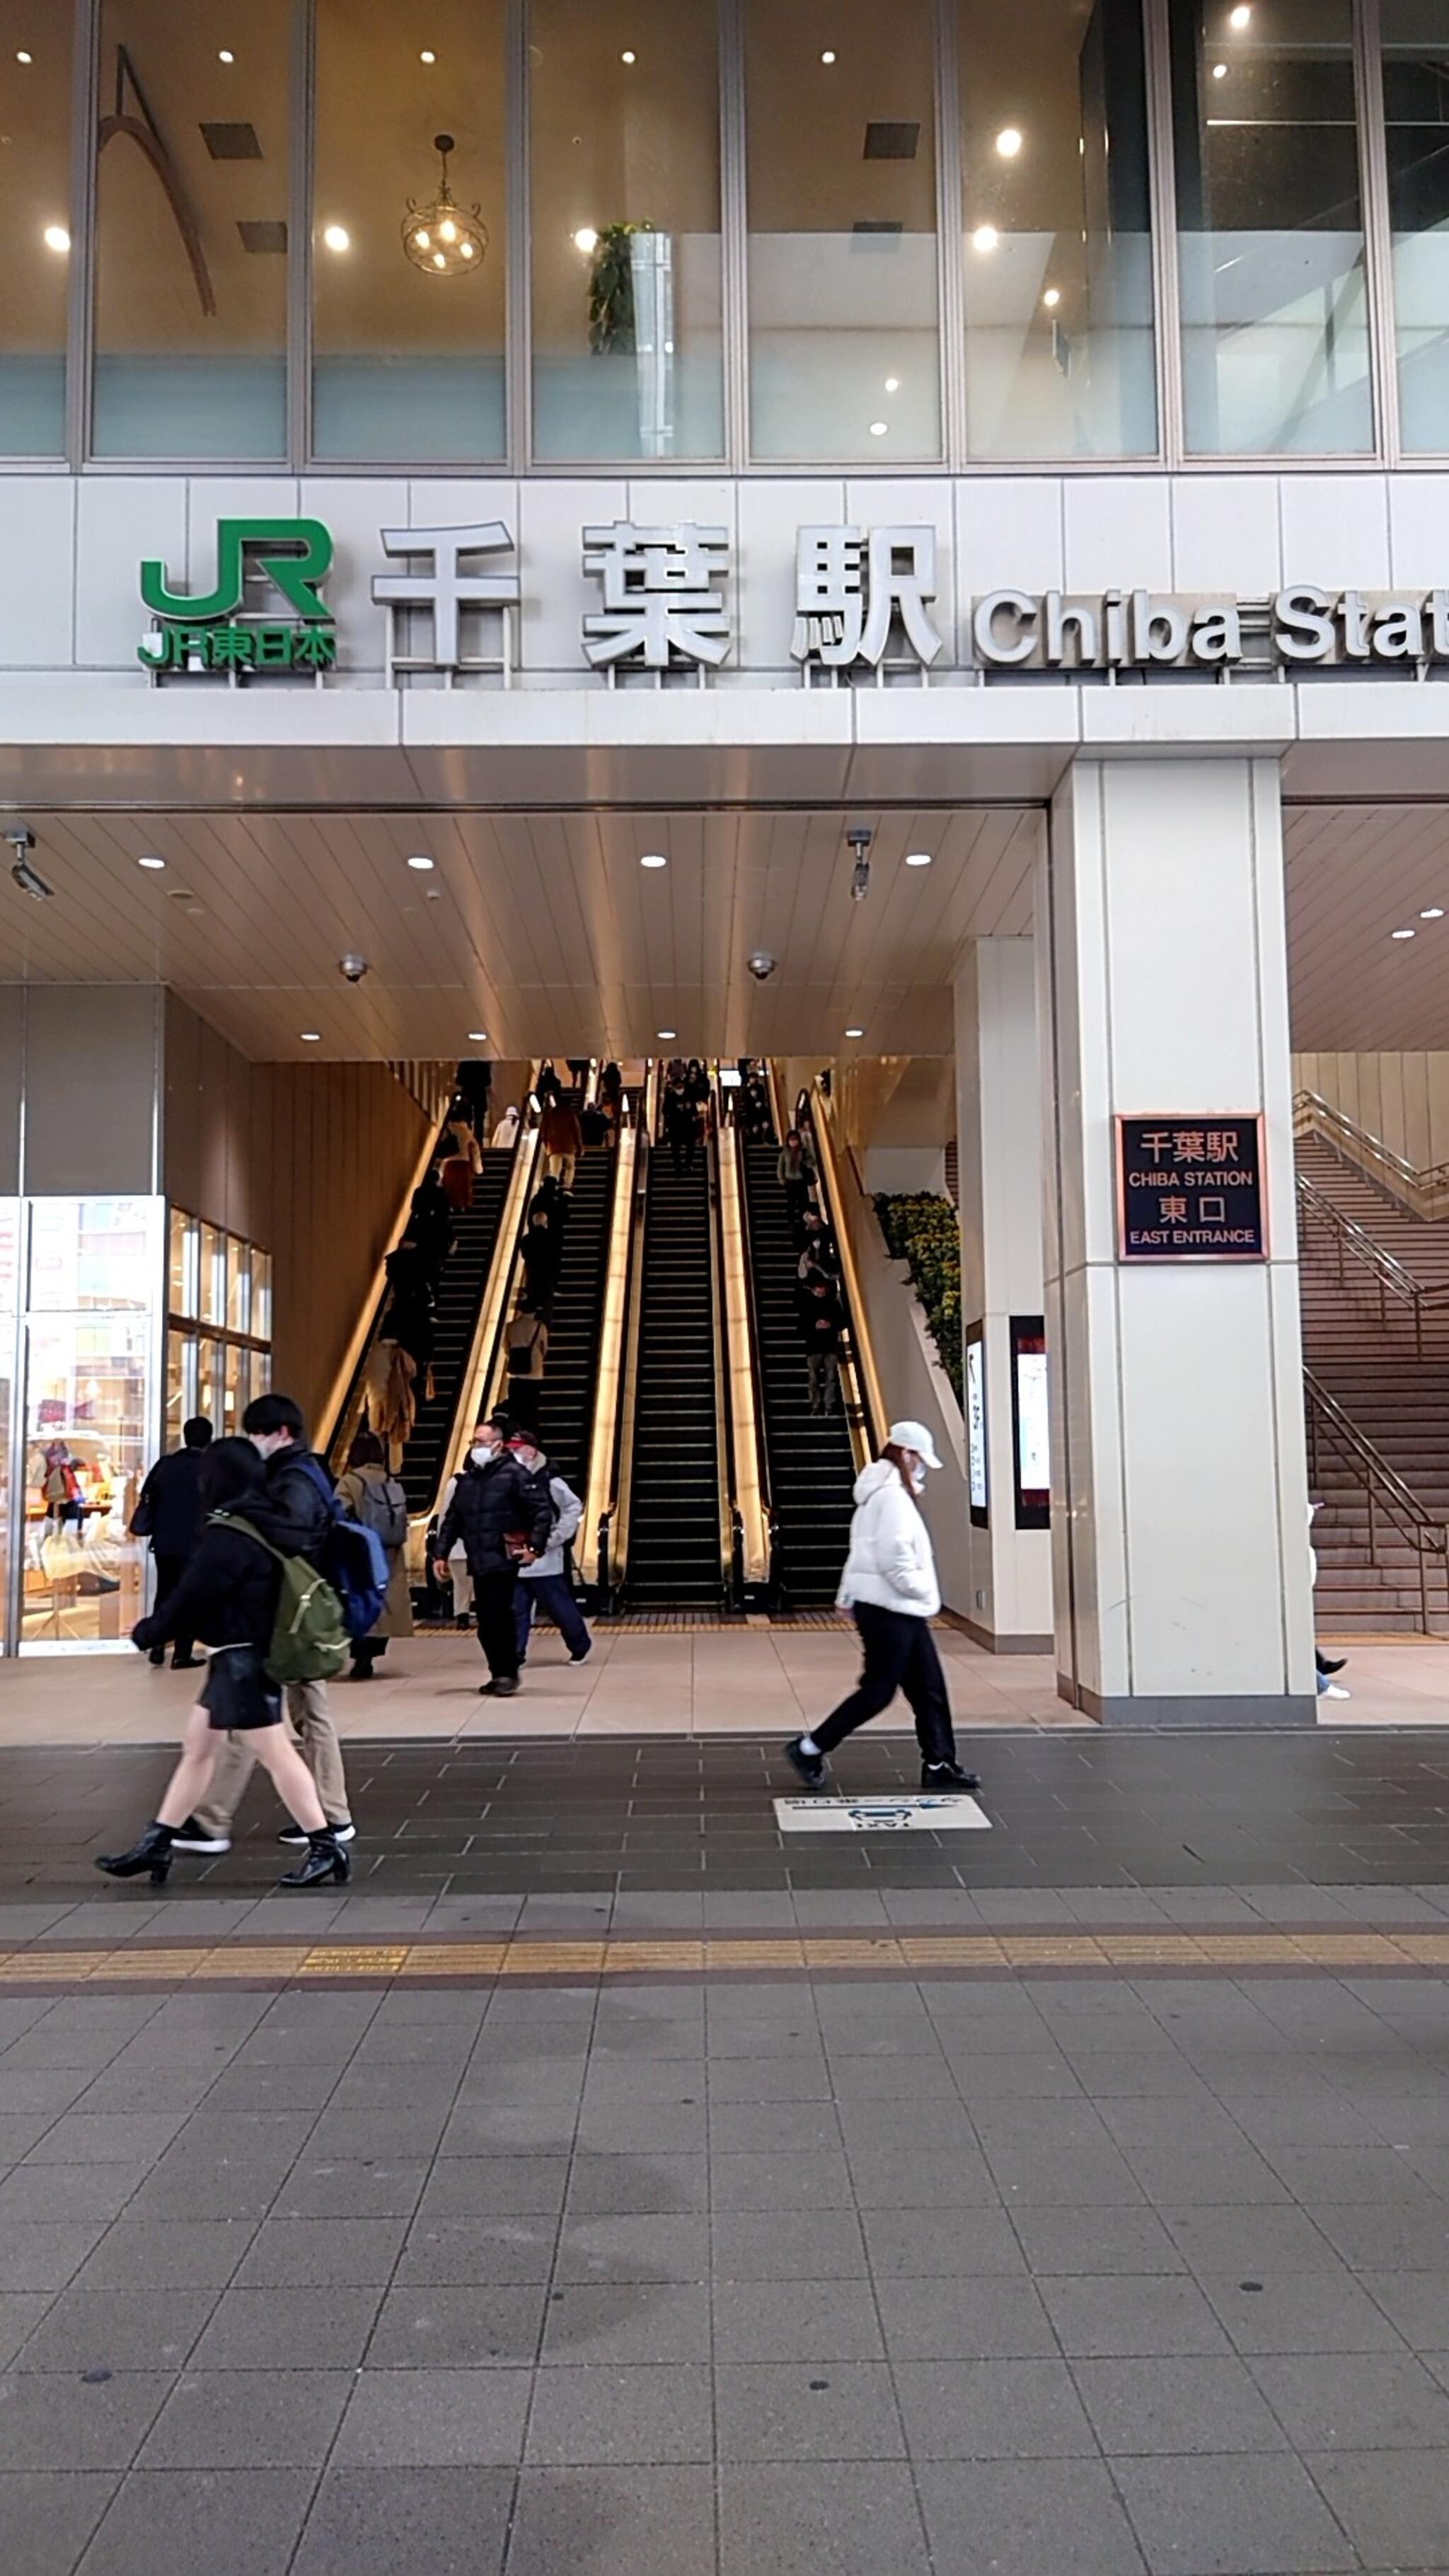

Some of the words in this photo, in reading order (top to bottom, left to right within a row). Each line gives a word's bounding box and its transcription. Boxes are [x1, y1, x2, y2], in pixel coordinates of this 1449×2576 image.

[141, 518, 335, 624] JR
[371, 520, 942, 666] 千葉駅
[974, 589, 1242, 665] Chiba
[137, 625, 336, 669] JR東日本
[1141, 1131, 1239, 1164] 千葉駅
[1128, 1172, 1179, 1187] CHIBA
[1184, 1171, 1253, 1186] STATION
[1159, 1195, 1225, 1224] 東口
[1130, 1230, 1170, 1244] EAST
[1172, 1230, 1255, 1244] ENTRANCE
